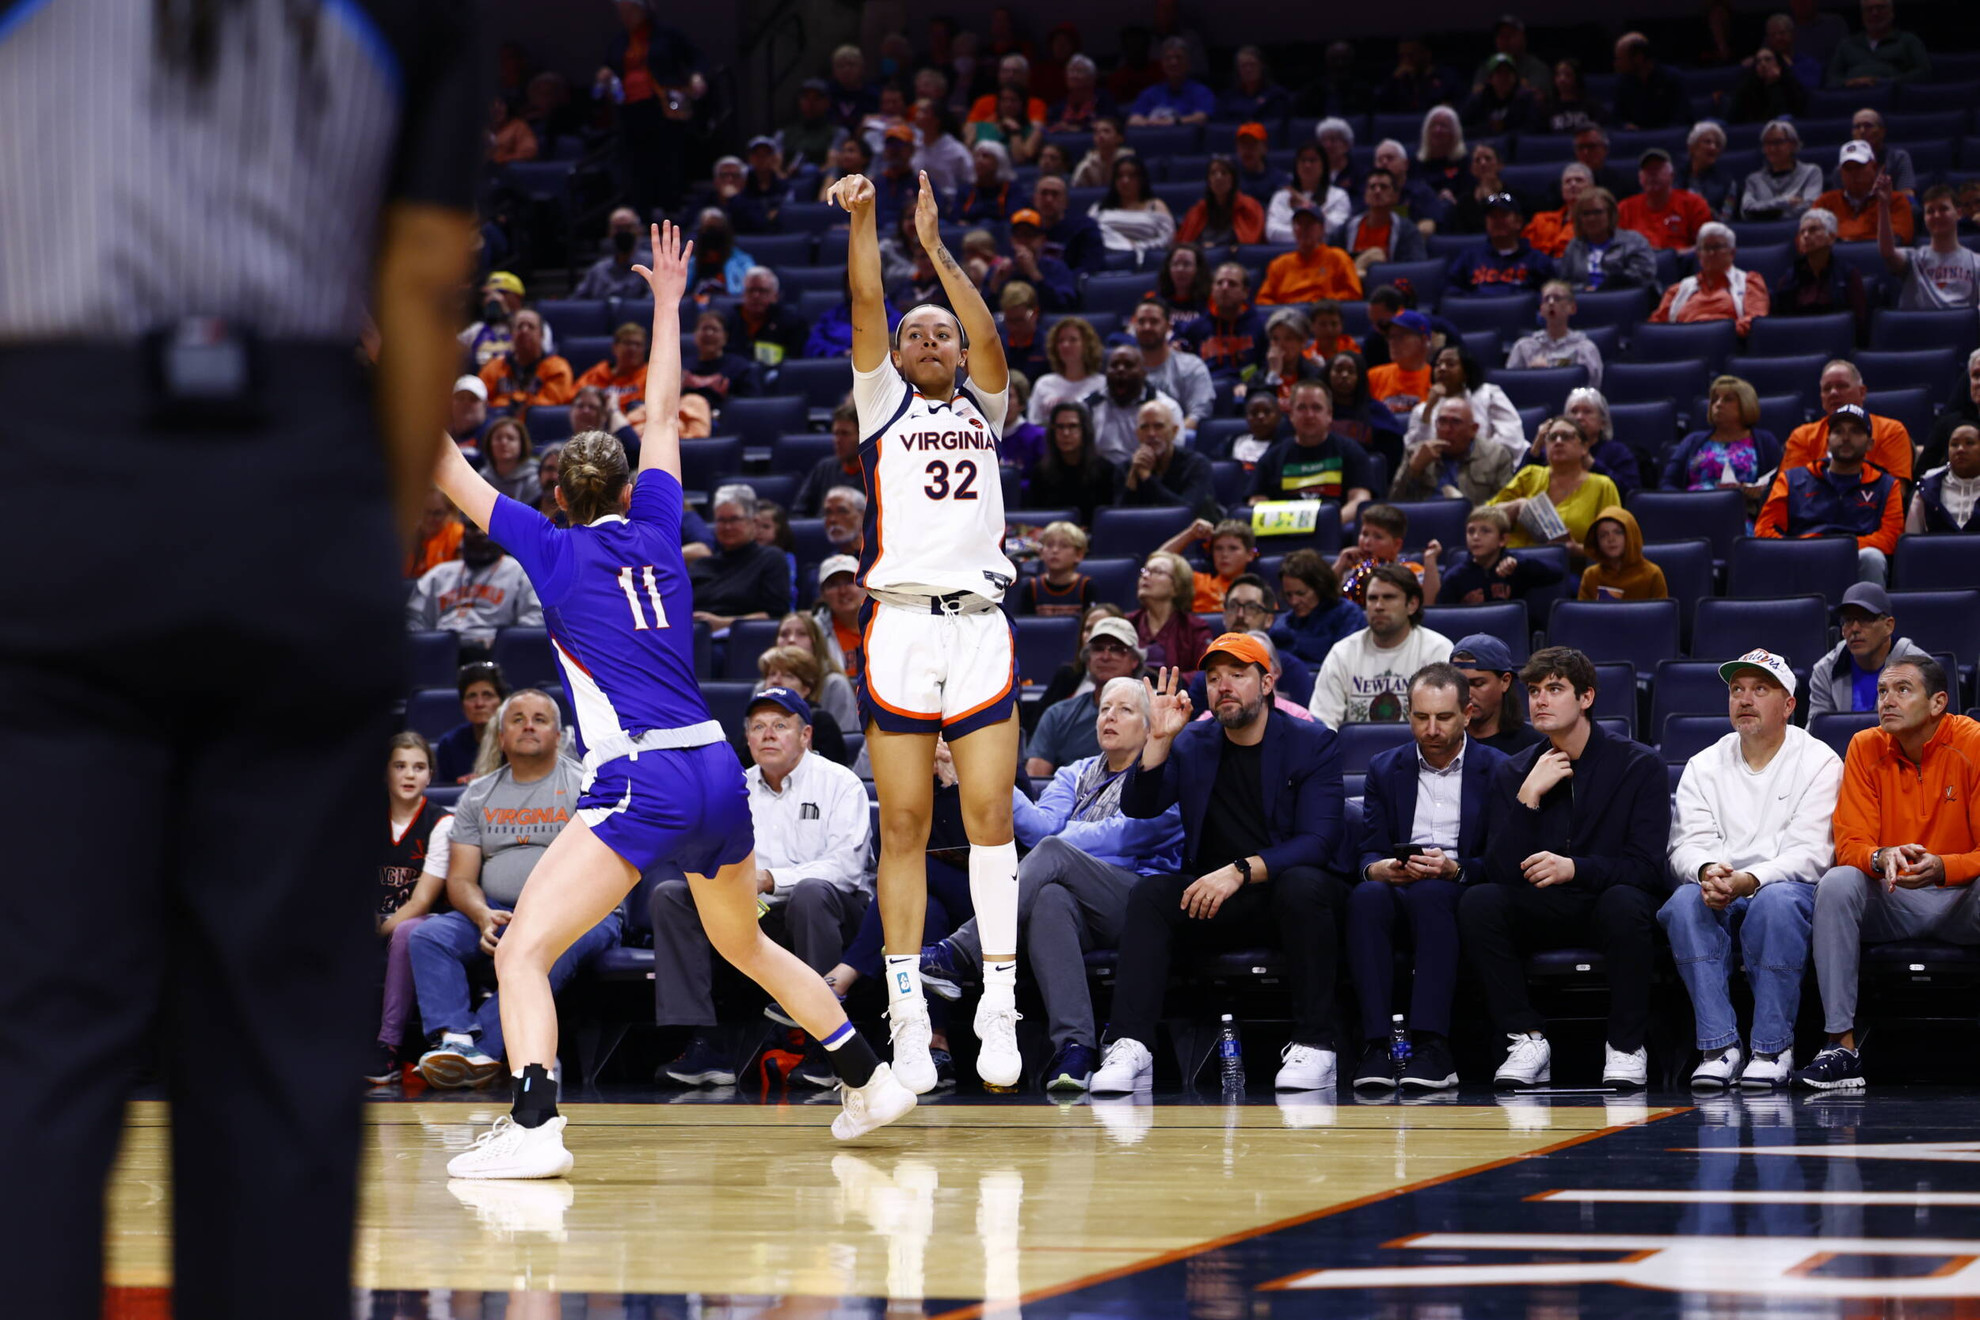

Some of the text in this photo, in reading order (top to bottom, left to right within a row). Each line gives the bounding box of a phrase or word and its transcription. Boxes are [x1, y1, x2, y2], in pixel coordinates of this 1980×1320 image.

[899, 430, 995, 452] VIRGINIA
[924, 459, 978, 501] 32
[617, 565, 672, 631] 11
[483, 806, 570, 825] VIRGINIA
